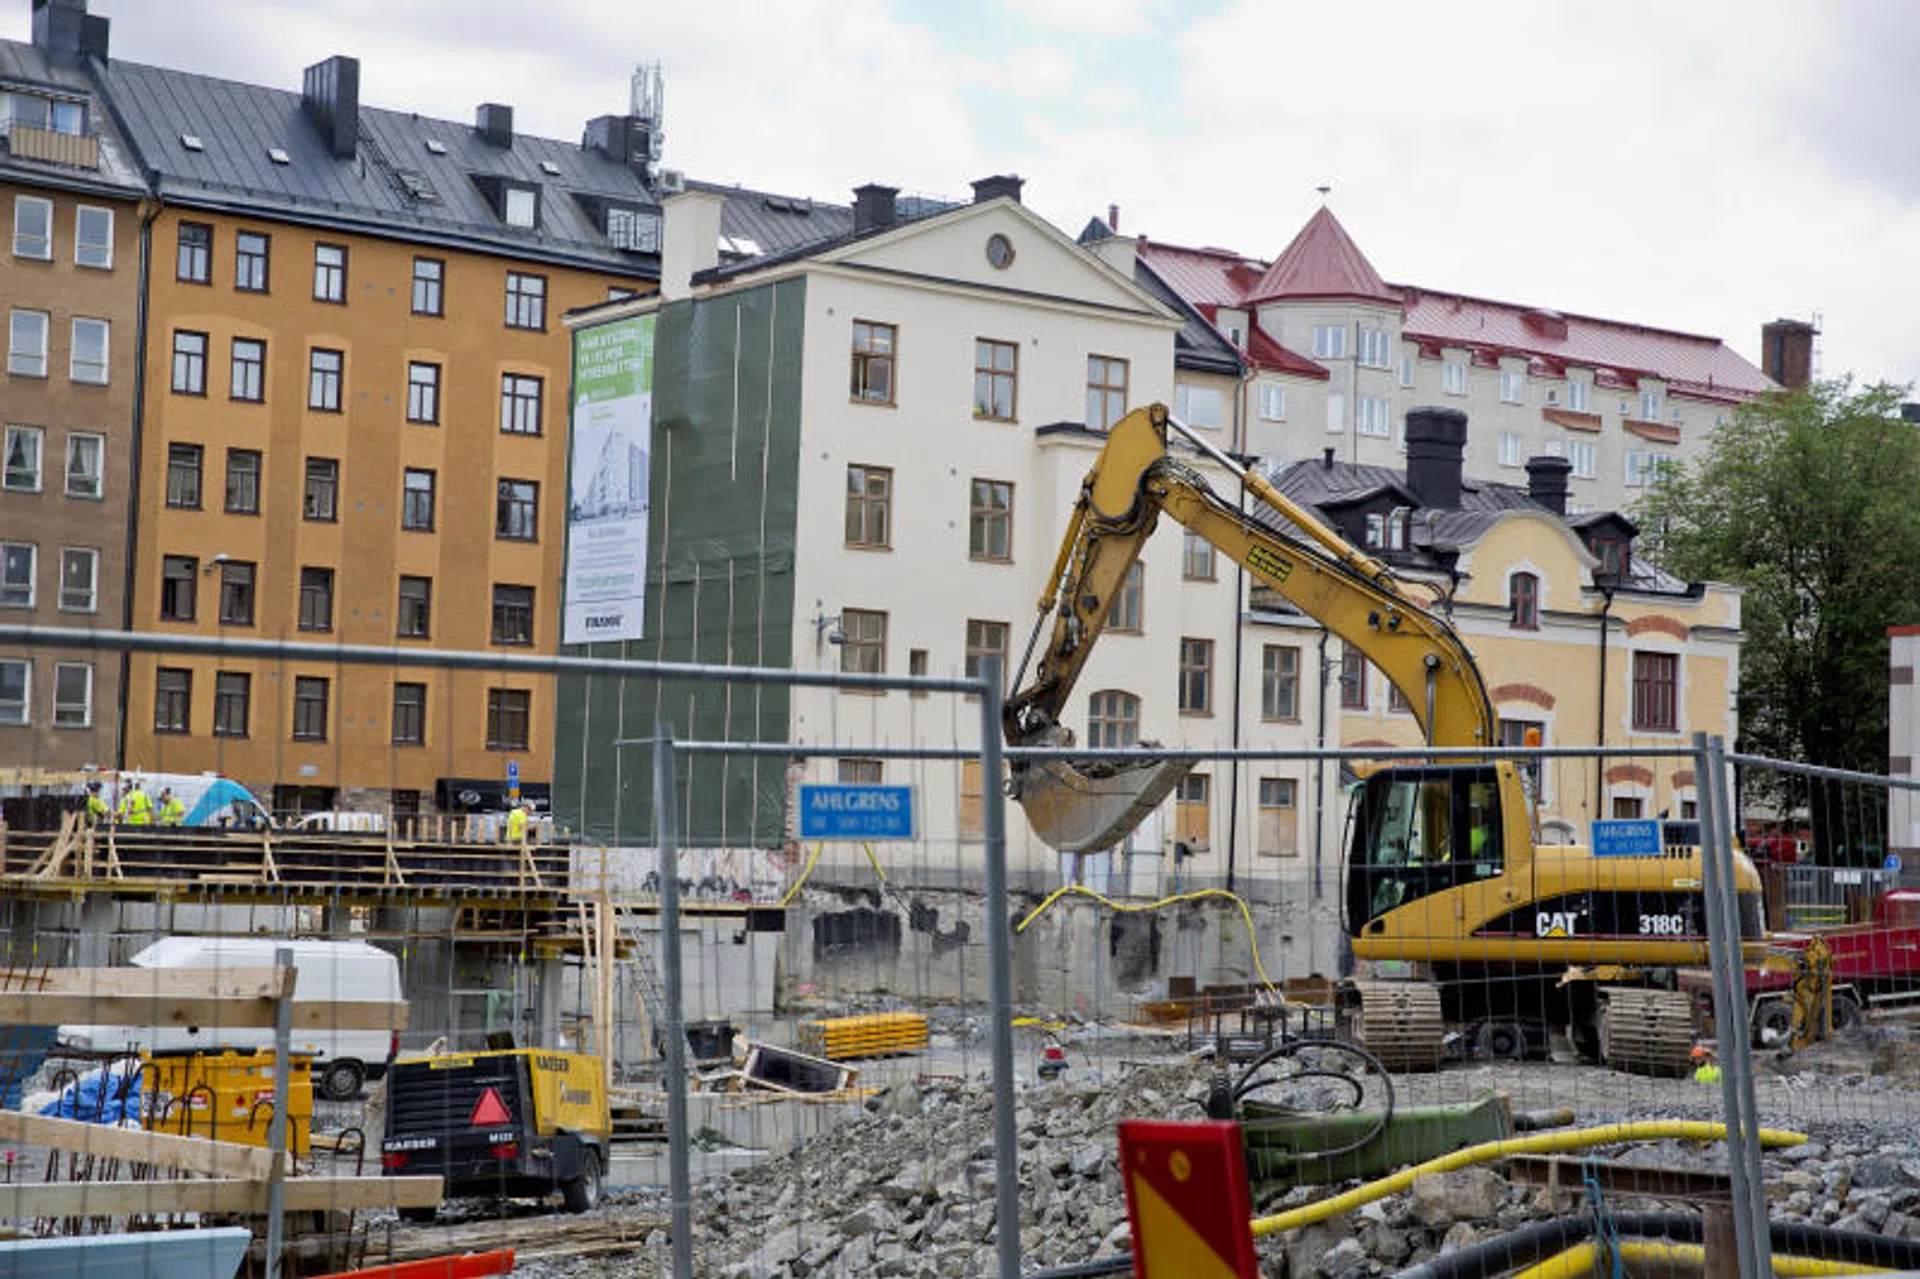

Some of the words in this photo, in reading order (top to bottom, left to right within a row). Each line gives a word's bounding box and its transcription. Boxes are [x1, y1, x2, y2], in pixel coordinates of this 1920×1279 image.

[811, 791, 899, 811] AHLGRENS
[1536, 911, 1578, 937] CAT
[1639, 914, 1683, 934] 318C
